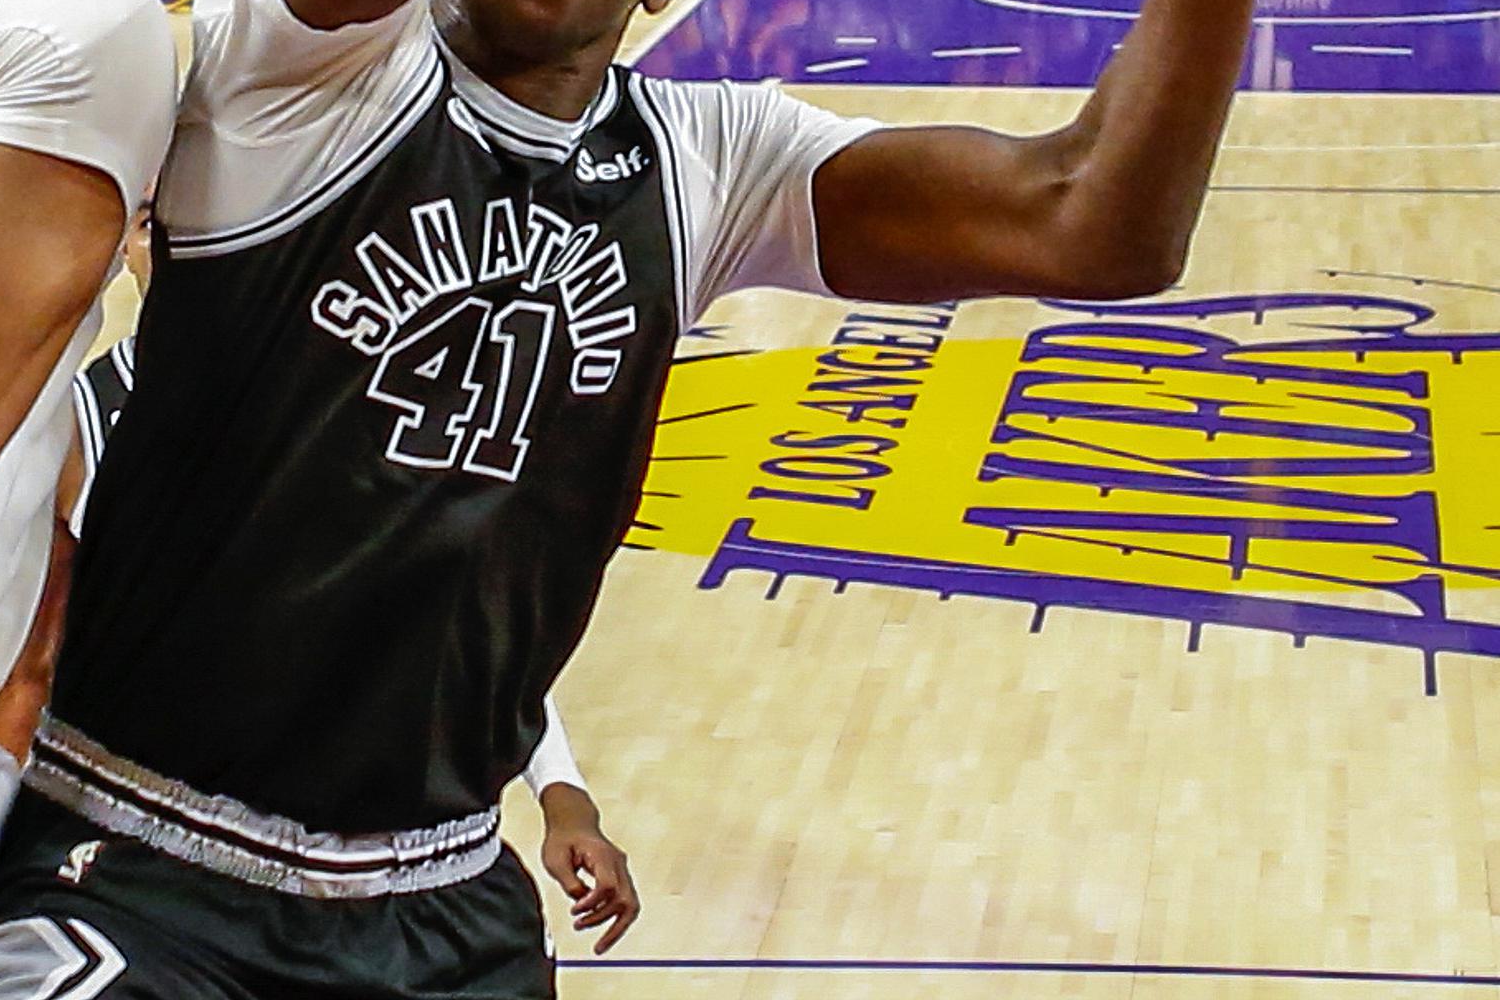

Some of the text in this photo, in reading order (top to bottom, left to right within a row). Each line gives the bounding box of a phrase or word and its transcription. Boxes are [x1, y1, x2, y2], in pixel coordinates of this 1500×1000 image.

[311, 198, 475, 356] SAN
[366, 296, 557, 483] 41
[747, 301, 957, 511] LOS ANGEL
